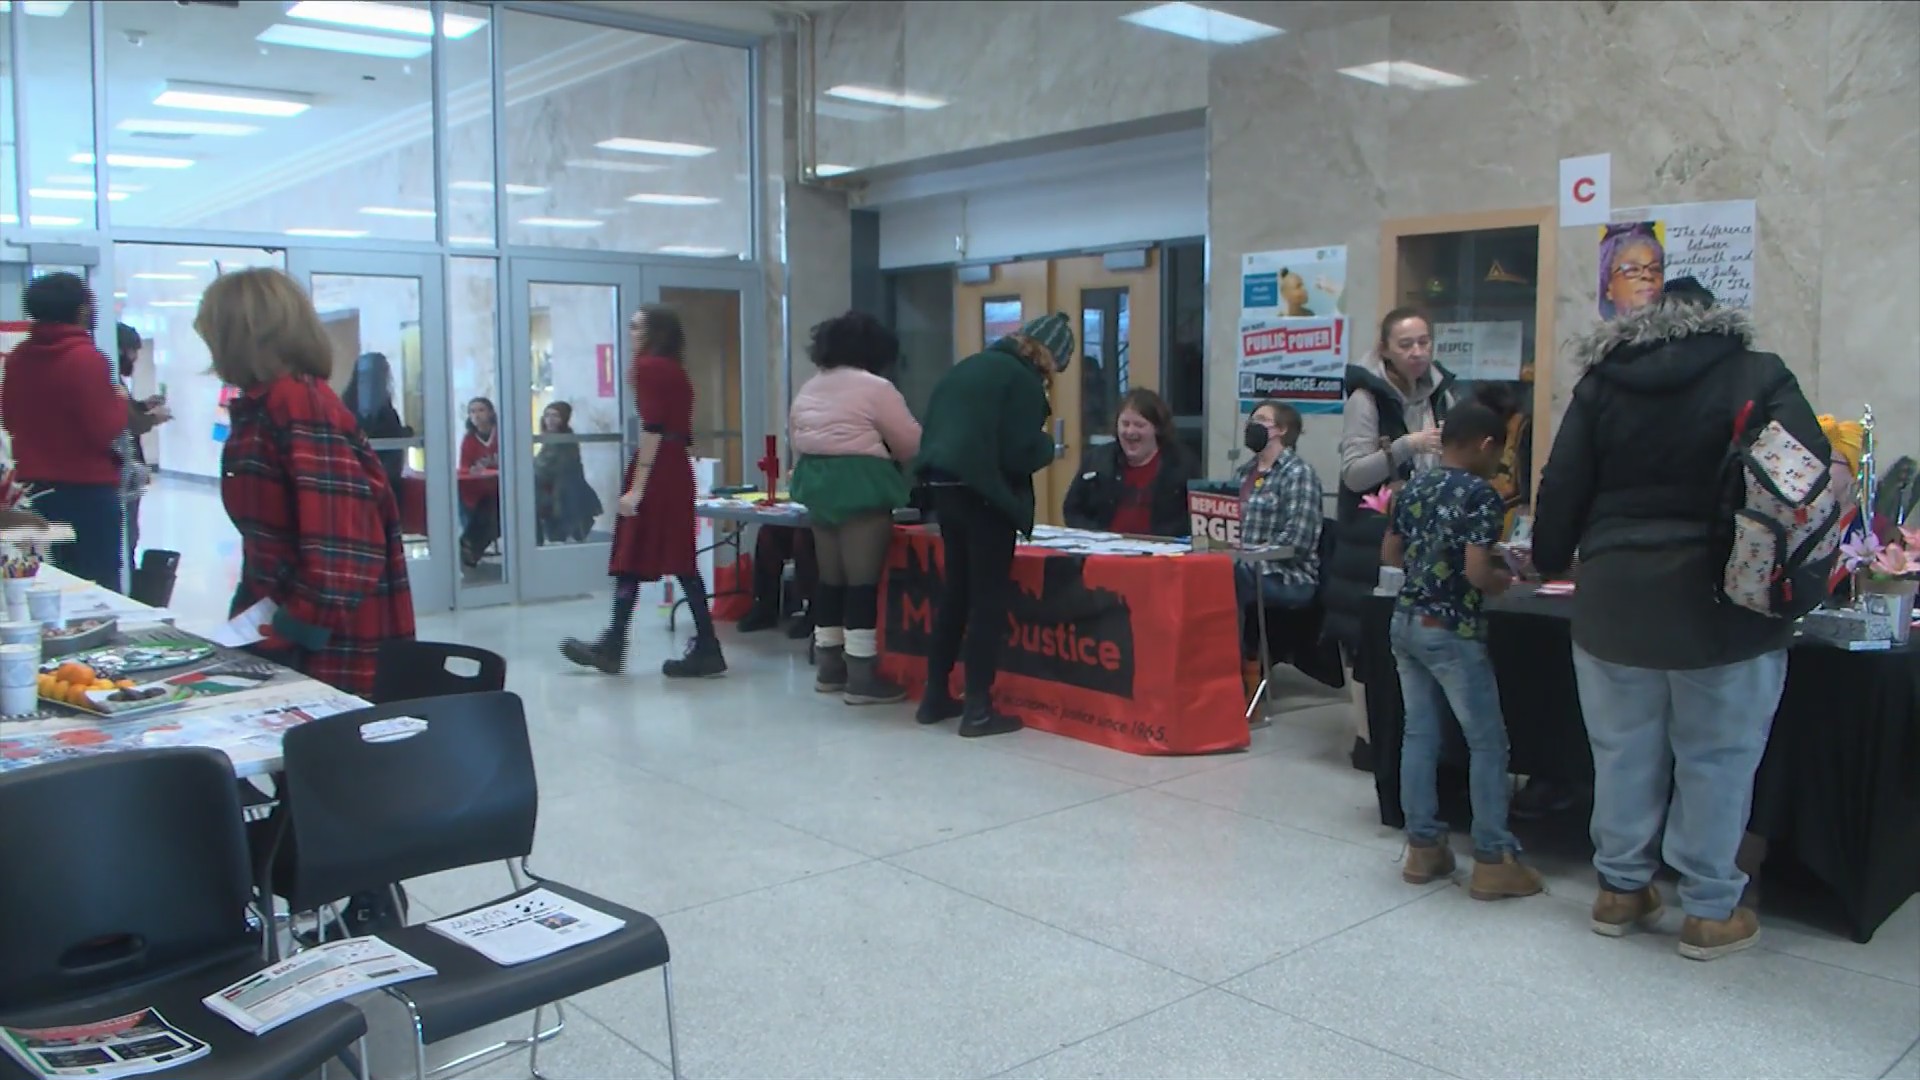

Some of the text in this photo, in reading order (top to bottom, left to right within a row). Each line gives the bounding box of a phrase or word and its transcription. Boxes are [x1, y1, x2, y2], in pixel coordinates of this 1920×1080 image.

[1572, 177, 1595, 203] C
[1699, 223, 1752, 239] difference
[1687, 238, 1730, 251] between
[1246, 331, 1286, 353] PUBLIC
[1256, 377, 1341, 395] ReplaceRGE.com
[1191, 496, 1239, 518] REPLACE
[1190, 513, 1241, 543] RGE
[1096, 716, 1127, 735] since
